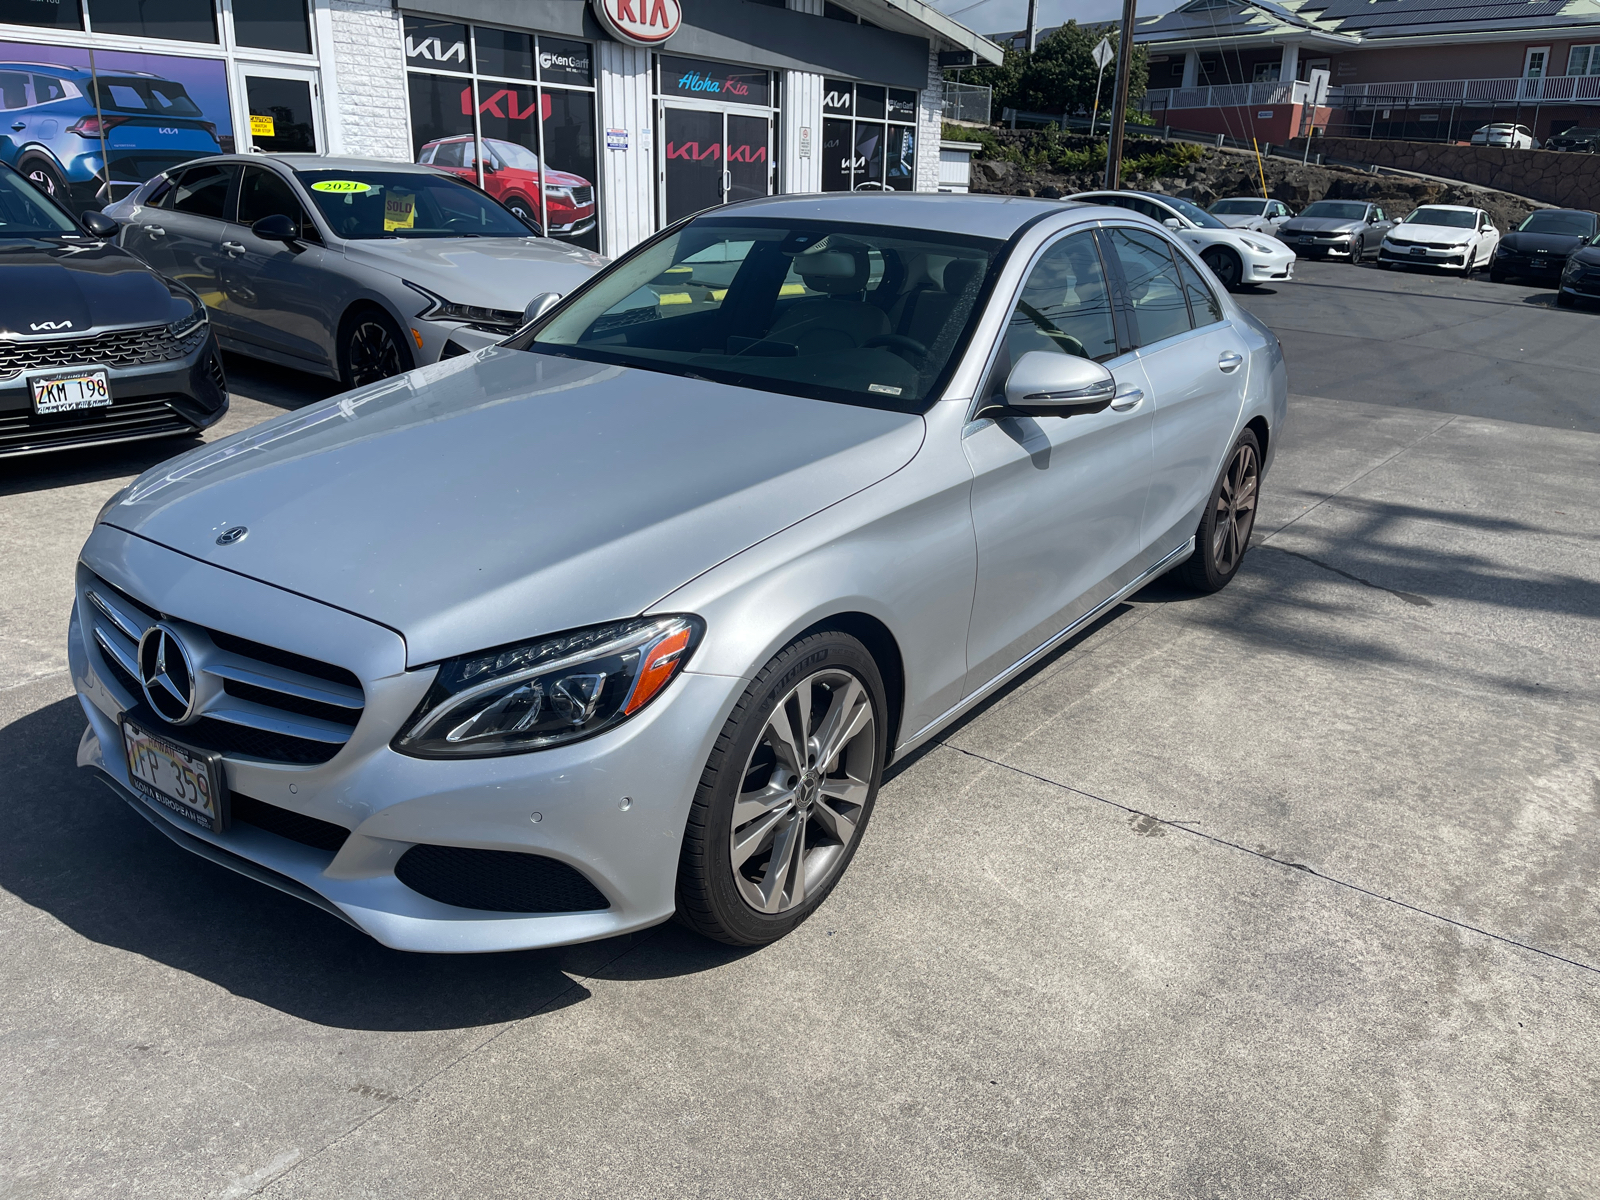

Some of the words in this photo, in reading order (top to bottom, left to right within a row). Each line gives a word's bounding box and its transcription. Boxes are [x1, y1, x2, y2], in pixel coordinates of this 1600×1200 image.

[617, 0, 669, 29] KIA
[406, 34, 465, 64] KIA
[551, 53, 568, 66] Ken
[569, 57, 589, 69] Garff
[679, 70, 720, 93] Aloha
[722, 75, 749, 96] Kia
[667, 141, 720, 160] KIA
[727, 145, 766, 163] KIA
[324, 183, 359, 191] 2021
[386, 200, 412, 213] SOLD
[30, 321, 73, 331] KIA
[35, 383, 68, 404] ZKM
[77, 379, 106, 399] 198
[58, 403, 76, 411] KIA
[774, 649, 827, 696] MICHELIN
[148, 738, 175, 758] HAWAII
[125, 733, 159, 784] TFP
[170, 760, 211, 809] 359
[155, 790, 196, 821] EUROPEAN
